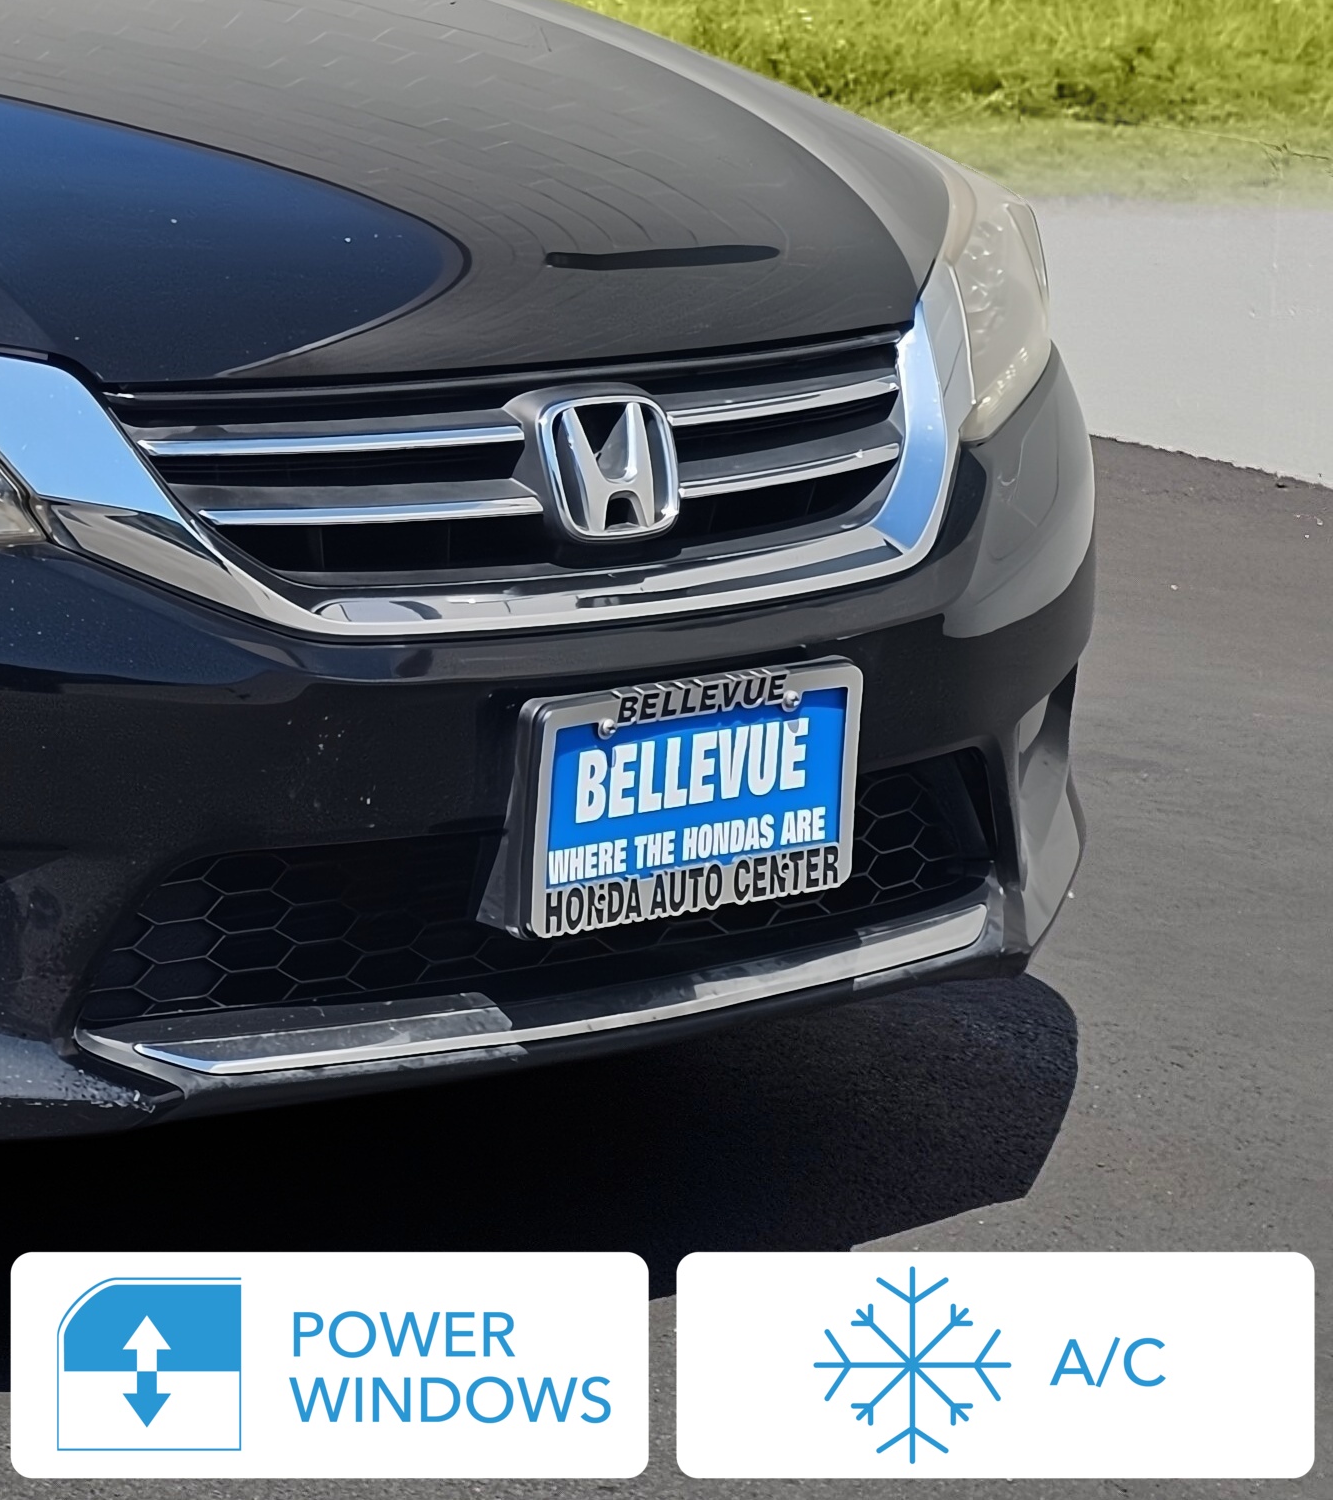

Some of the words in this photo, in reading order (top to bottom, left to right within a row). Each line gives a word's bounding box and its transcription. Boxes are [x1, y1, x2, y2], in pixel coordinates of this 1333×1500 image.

[617, 673, 788, 724] BELLEVUE
[575, 717, 810, 824] BELLEVUE
[548, 838, 628, 885] WHERE
[634, 830, 676, 870] THE
[682, 813, 775, 861] HONDAS
[780, 806, 827, 846] ARE
[545, 879, 643, 935] HONDA
[650, 863, 723, 917] AUTO
[733, 845, 840, 902] CENTER
